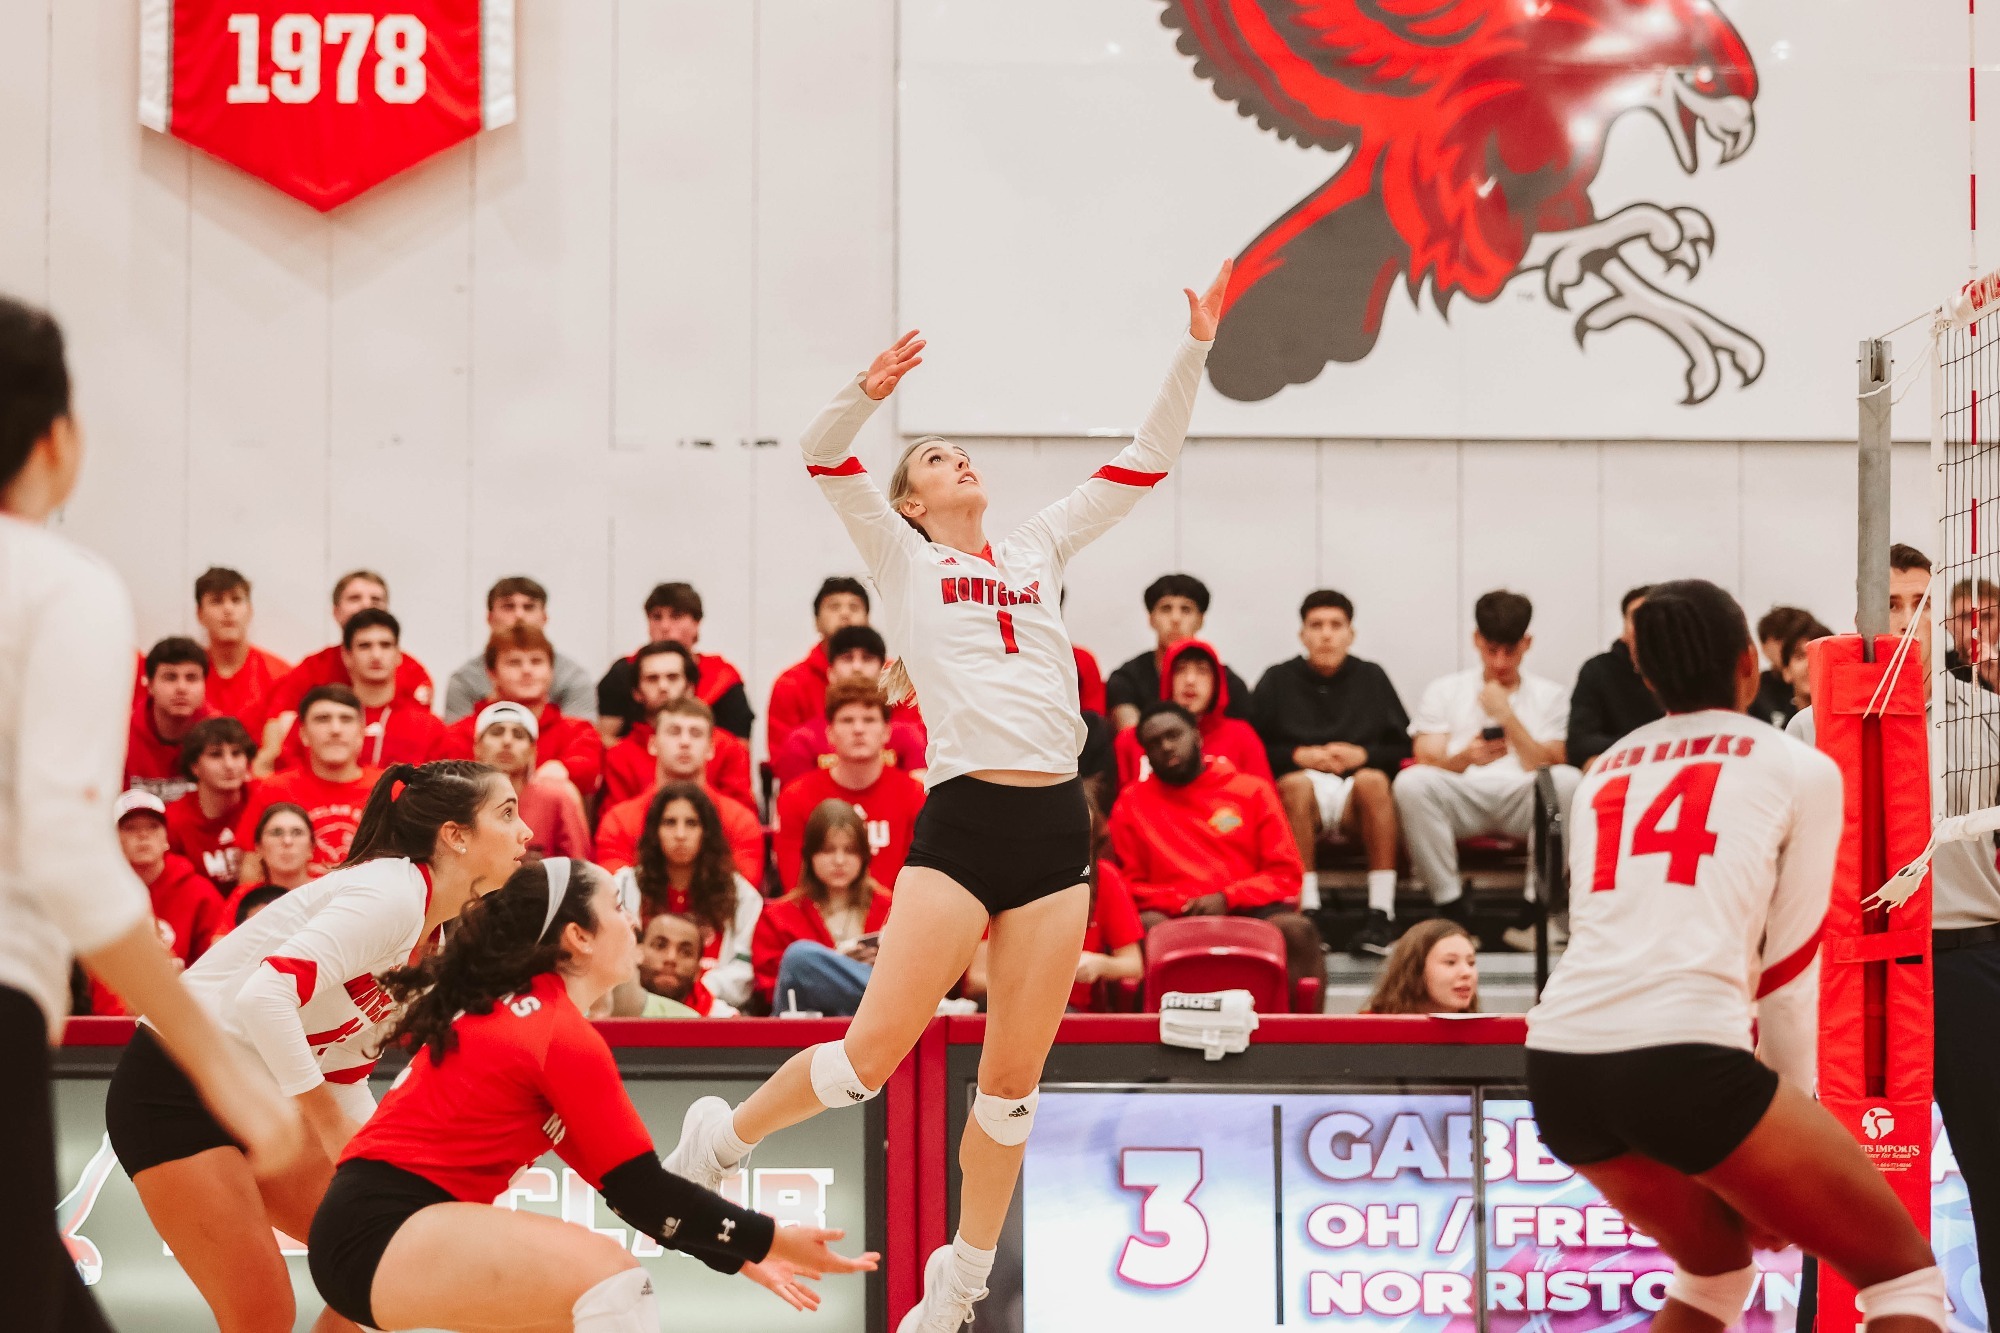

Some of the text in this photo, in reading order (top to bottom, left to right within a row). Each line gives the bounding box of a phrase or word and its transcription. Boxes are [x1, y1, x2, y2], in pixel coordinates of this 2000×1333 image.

[226, 13, 428, 104] 1978
[996, 609, 1020, 654] 1
[1652, 734, 1755, 763] HAWKS
[1590, 761, 1723, 893] 14
[1307, 1110, 1576, 1184] GABB
[1116, 1146, 1210, 1287] 3
[1307, 1202, 1420, 1248] OH
[1435, 1194, 1476, 1253] /
[1308, 1269, 1803, 1315] NORRISTON
